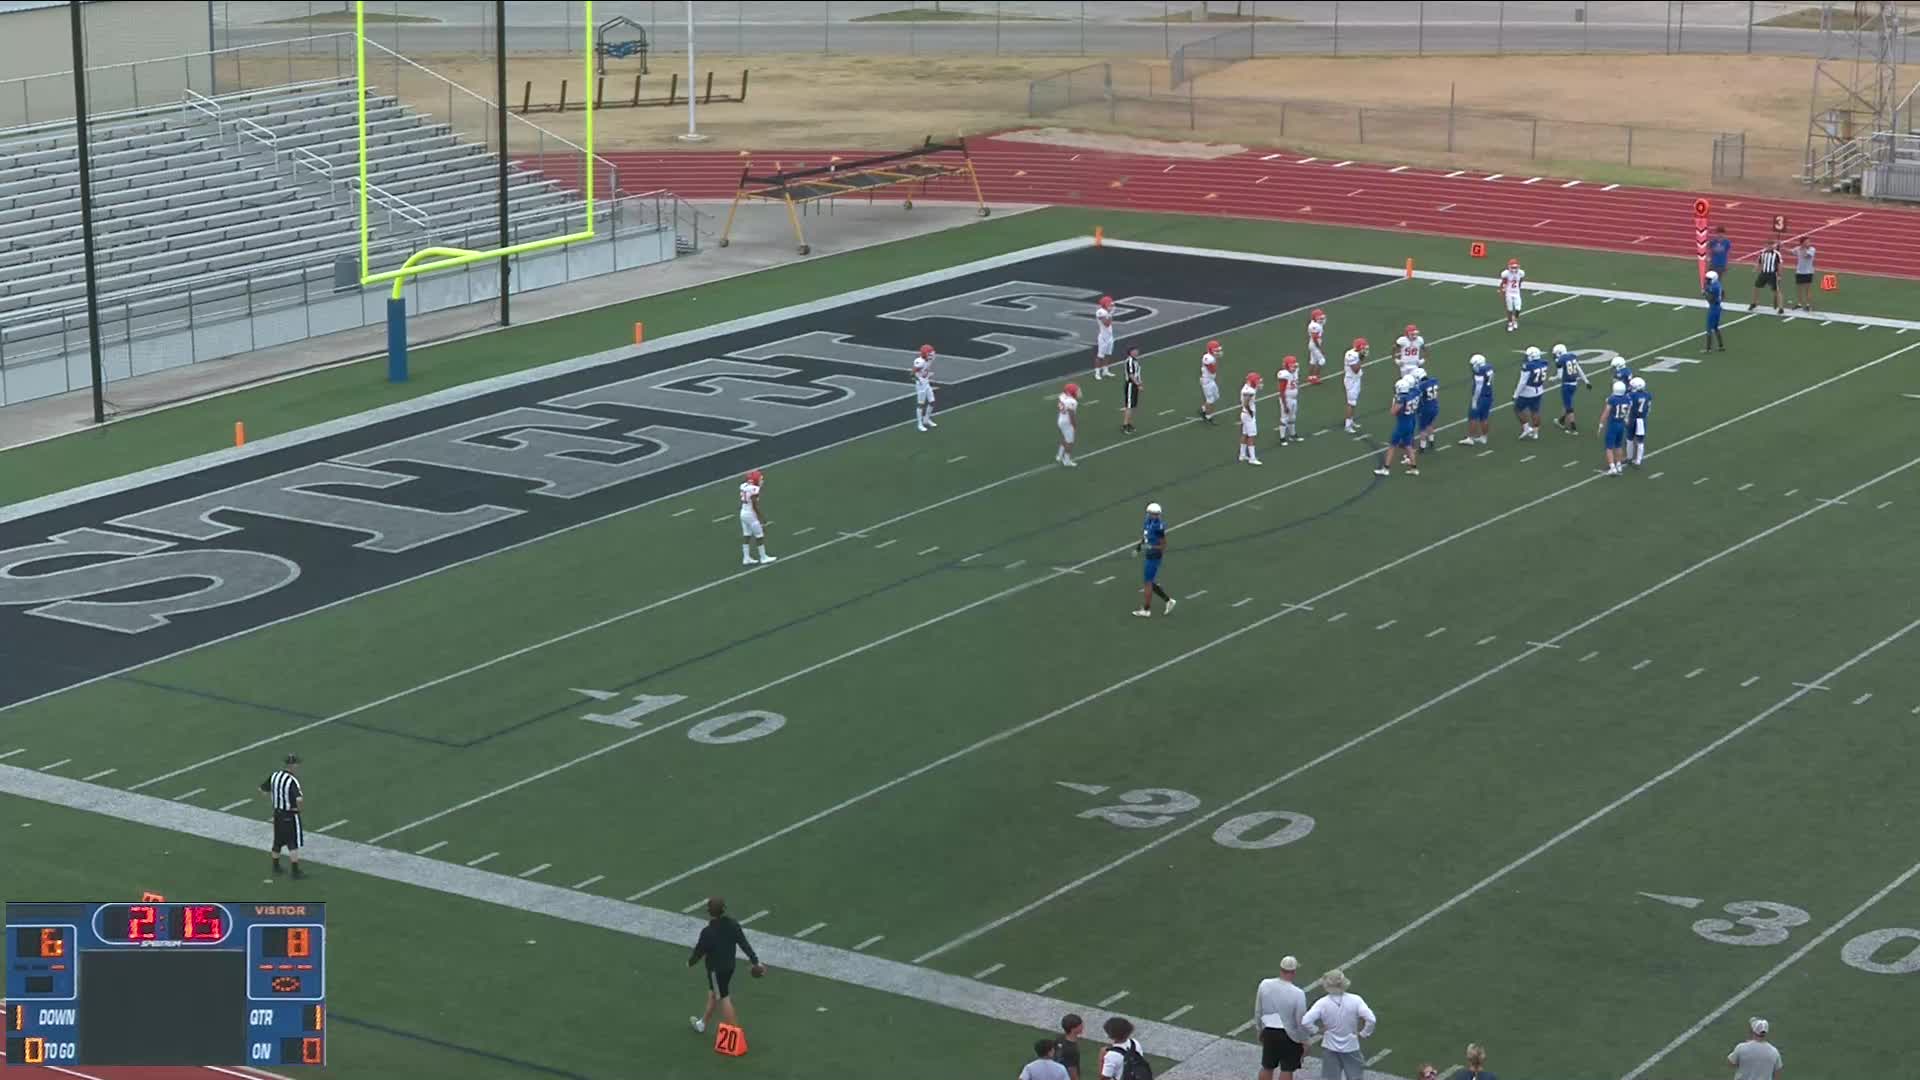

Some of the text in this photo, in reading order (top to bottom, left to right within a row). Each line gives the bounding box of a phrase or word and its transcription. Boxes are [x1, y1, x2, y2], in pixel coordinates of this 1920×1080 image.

[1775, 216, 1785, 230] 3
[1533, 366, 1548, 383] 75
[0, 281, 1230, 633] STEELE
[717, 1027, 737, 1052] 20
